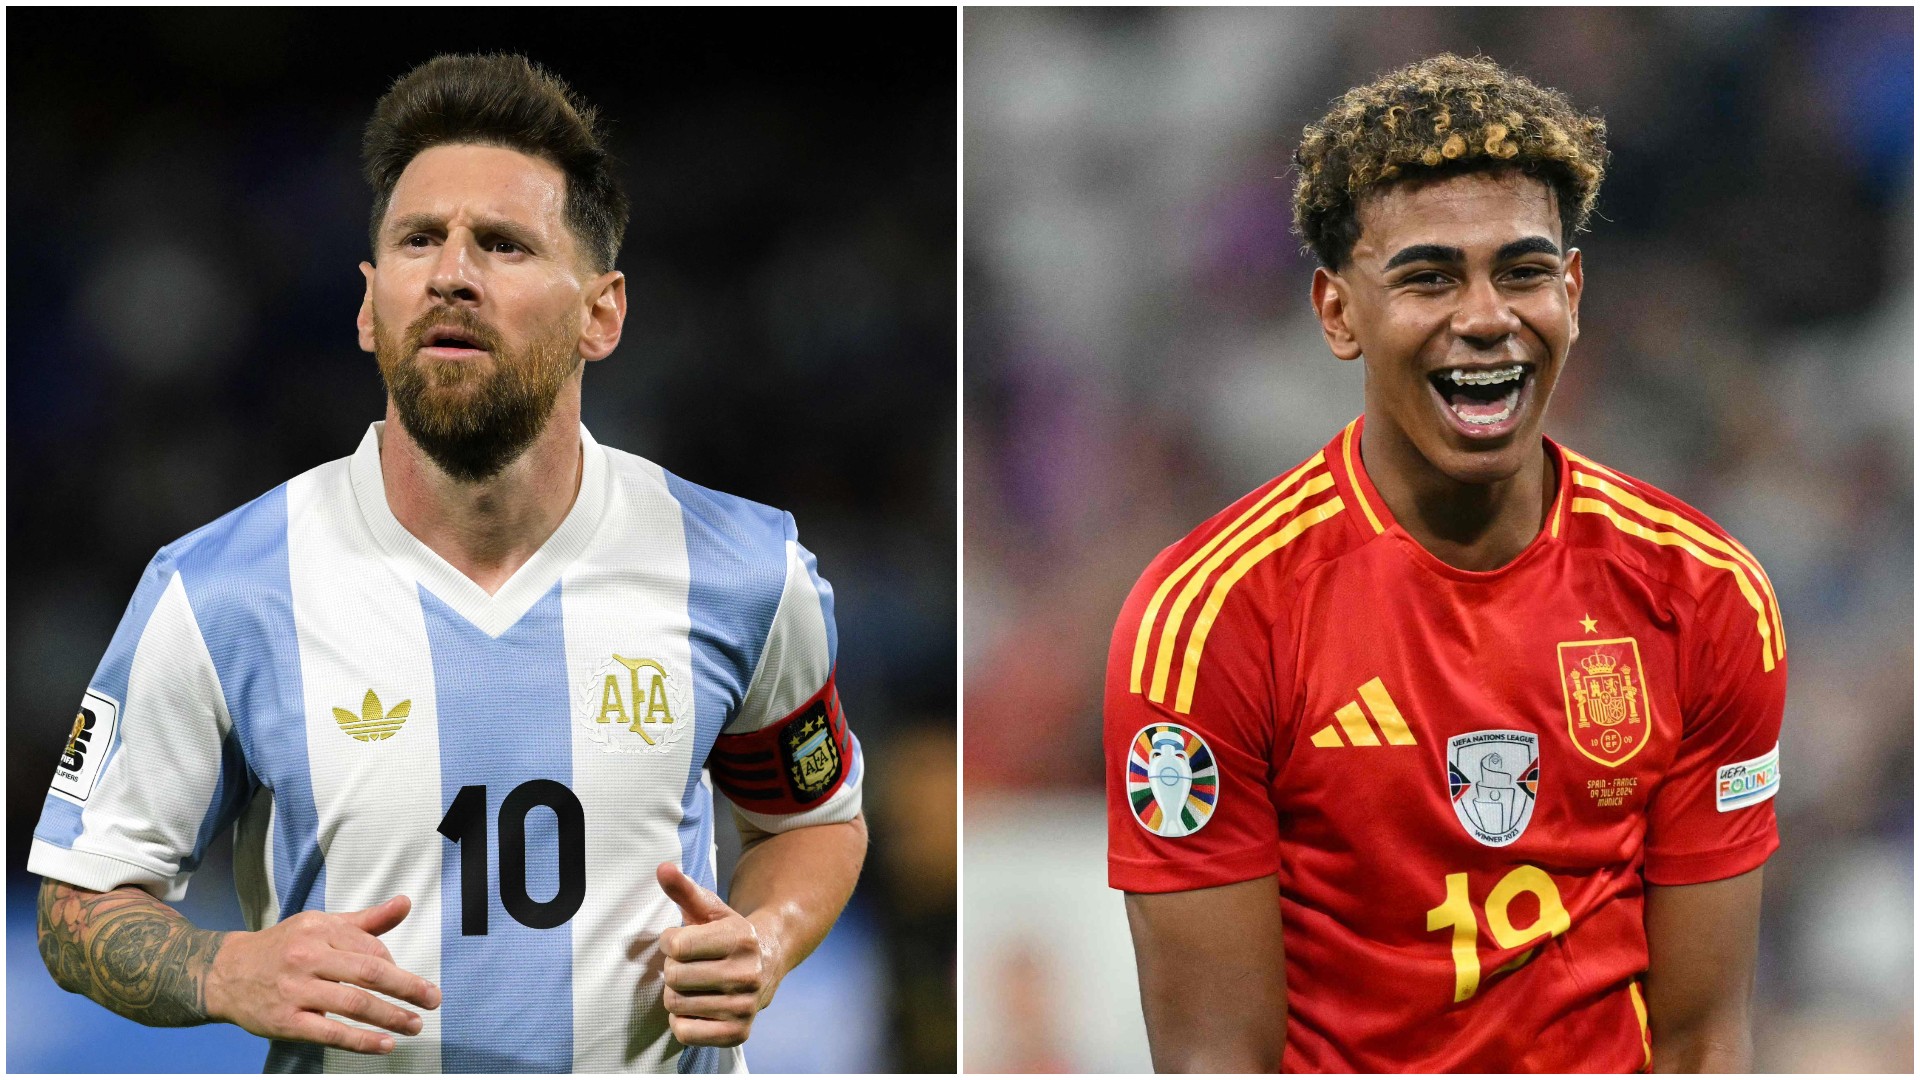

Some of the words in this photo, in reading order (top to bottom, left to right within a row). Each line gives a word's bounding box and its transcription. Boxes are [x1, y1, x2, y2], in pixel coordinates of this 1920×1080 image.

[596, 654, 674, 745] AFA
[1452, 738, 1472, 746] UEFA
[1473, 734, 1506, 742] NATIONS
[1507, 734, 1534, 744] LEAGUE
[1591, 738, 1598, 746] 19
[805, 746, 829, 777] AFA
[1720, 766, 1746, 779] UEFA
[1587, 779, 1606, 789] SPAIN
[1613, 777, 1638, 787] FRANCE
[1590, 790, 1599, 798] 09
[1600, 788, 1615, 797] JULY
[1616, 787, 1633, 796] 2024
[1598, 797, 1623, 806] MUNICH
[1475, 830, 1502, 842] WINNER
[1504, 828, 1519, 841] 2023
[437, 779, 586, 936] 10
[1427, 864, 1570, 1003] 19
